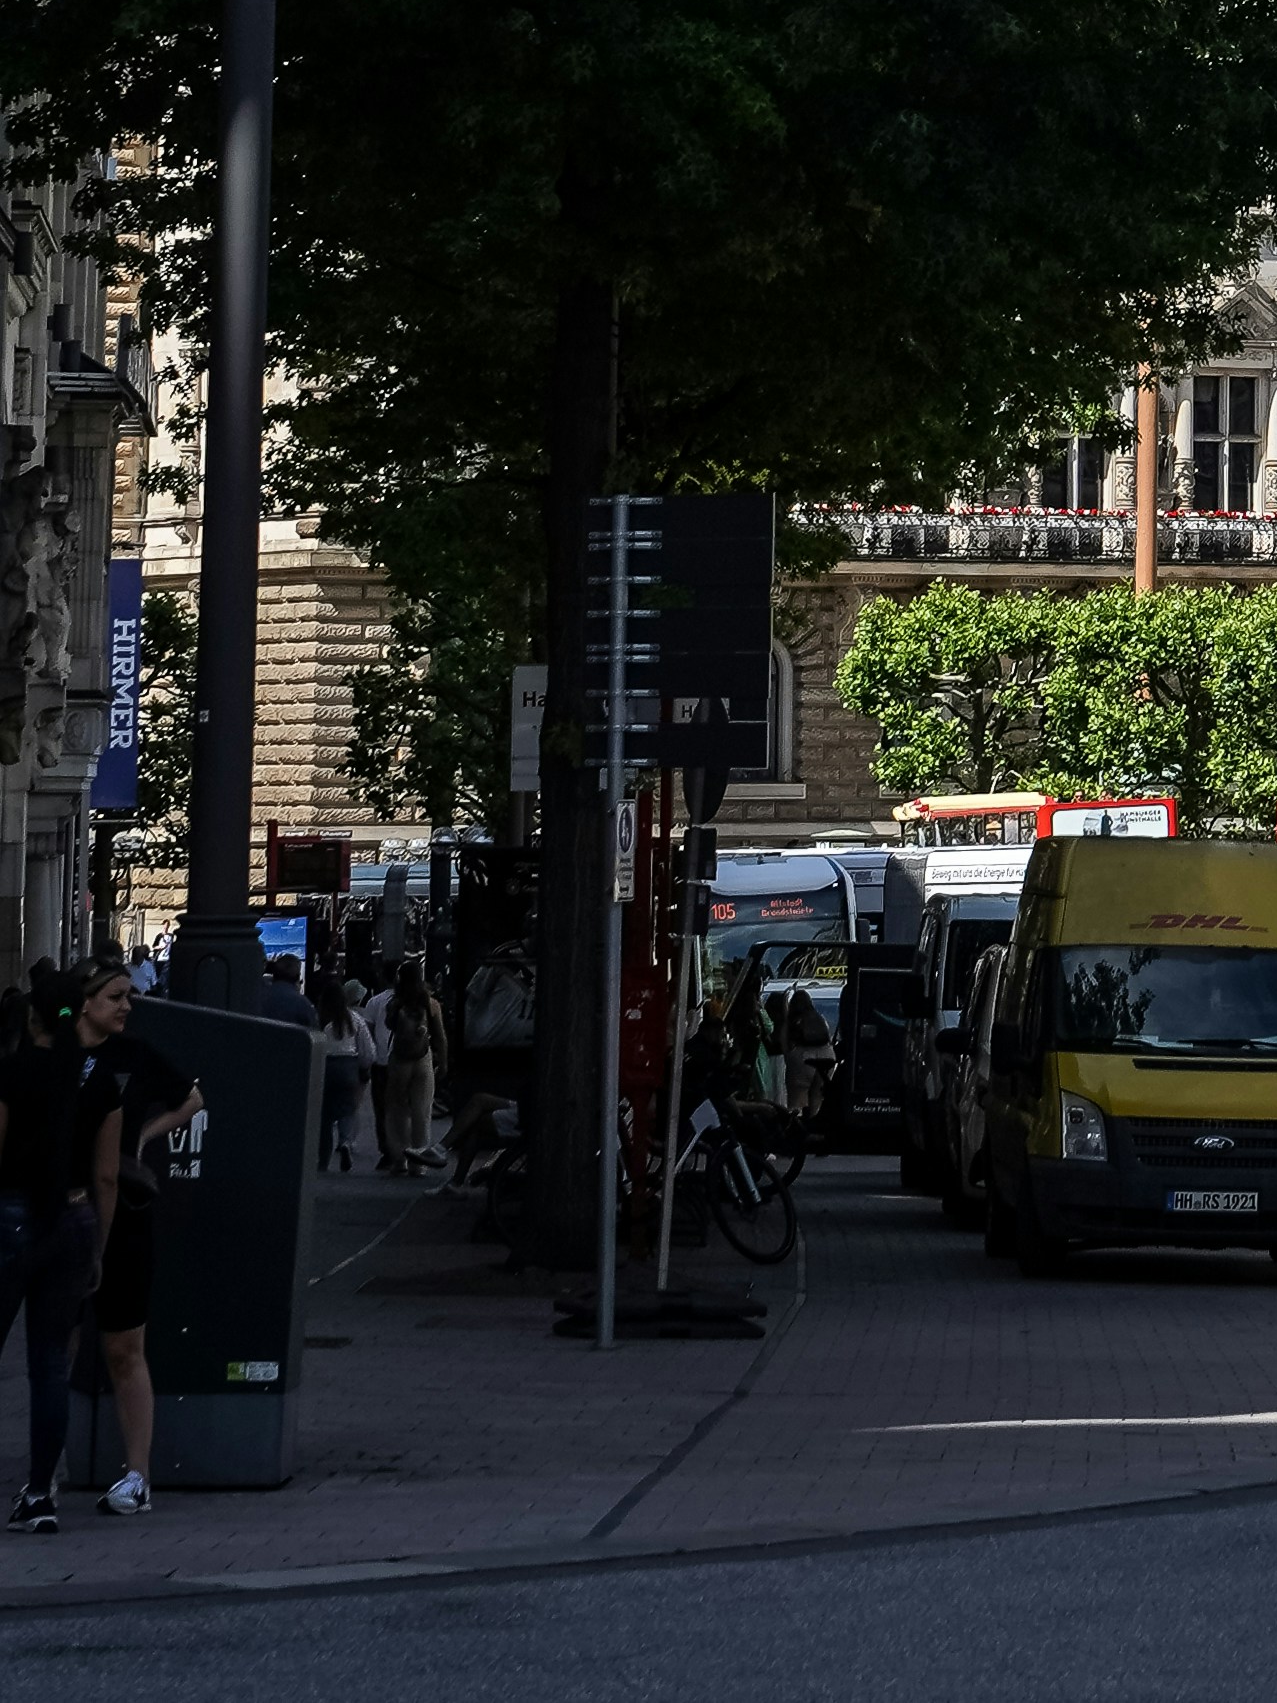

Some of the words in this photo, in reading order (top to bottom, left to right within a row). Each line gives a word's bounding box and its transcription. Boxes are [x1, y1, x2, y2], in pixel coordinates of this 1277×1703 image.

[109, 618, 137, 749] HIRMER
[711, 902, 737, 921] 105
[1149, 913, 1249, 931] DHL
[1174, 1193, 1194, 1210] HH
[1202, 1193, 1221, 1210] RS
[1222, 1193, 1257, 1210] 1921
